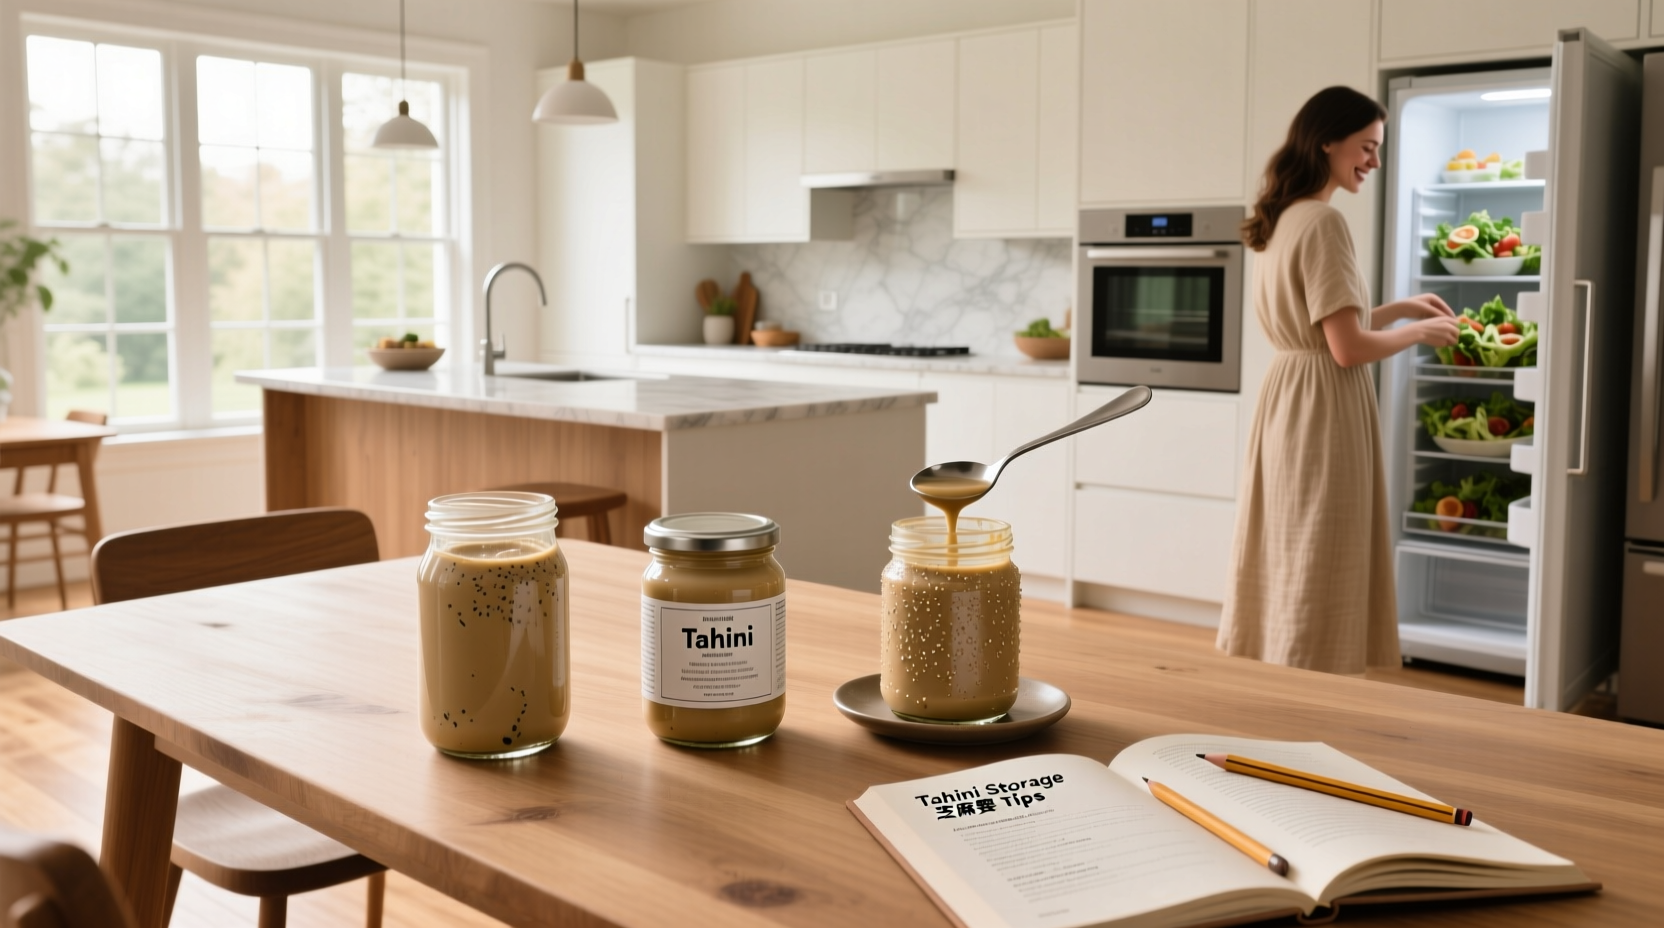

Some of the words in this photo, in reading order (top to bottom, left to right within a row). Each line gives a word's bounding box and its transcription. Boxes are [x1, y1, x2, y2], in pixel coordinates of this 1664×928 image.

[681, 624, 753, 649] Tahini
[914, 786, 981, 807] Tahini
[985, 773, 1064, 796] Storage
[1000, 792, 1046, 808] Tips
